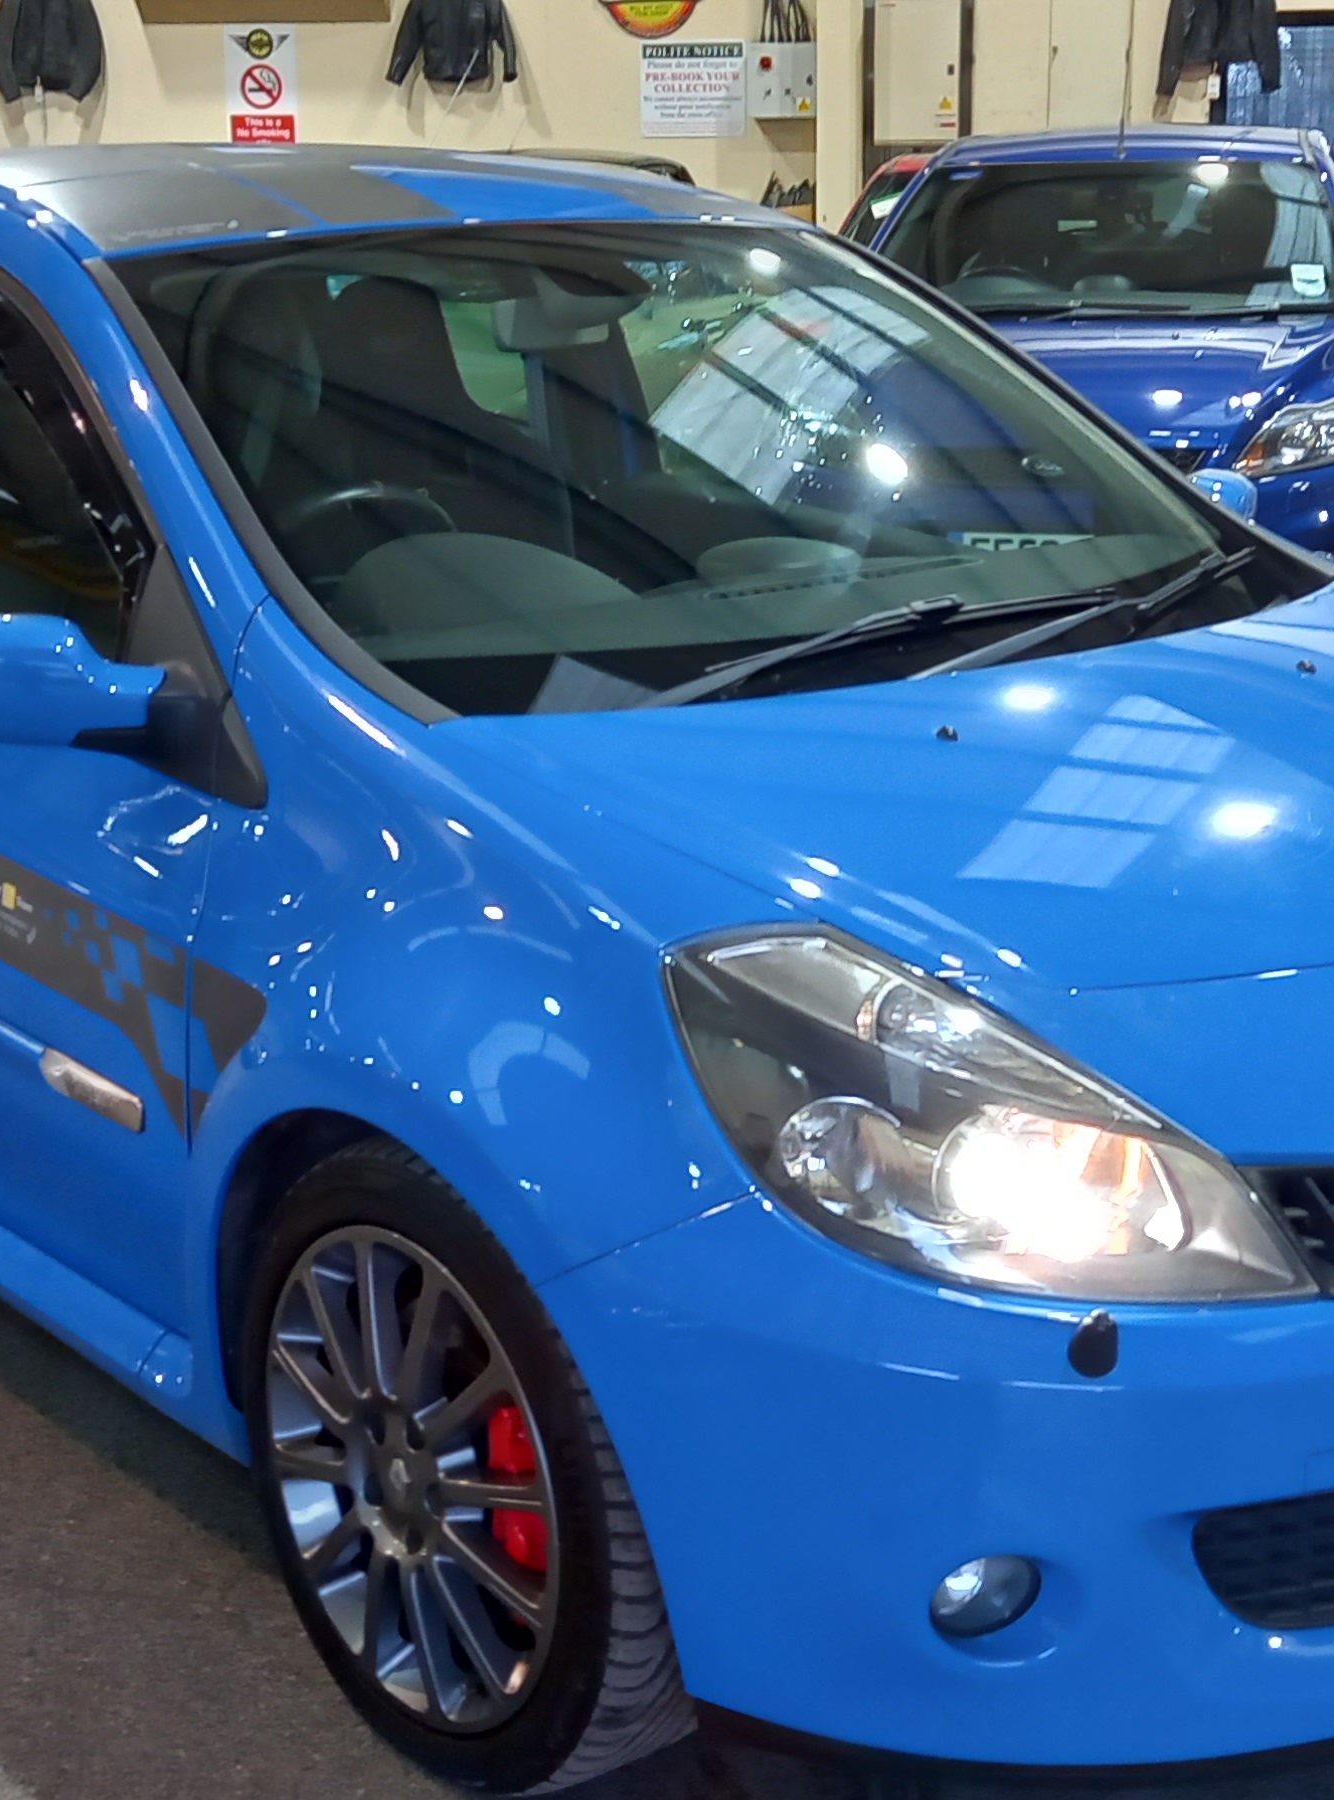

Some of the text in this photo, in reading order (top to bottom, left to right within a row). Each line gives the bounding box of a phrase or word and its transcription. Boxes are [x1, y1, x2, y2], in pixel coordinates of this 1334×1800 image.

[645, 45, 741, 57] POLITE NOTICE
[674, 60, 685, 69] do
[687, 61, 701, 69] not
[645, 71, 740, 82] PRE-BOOK YOUR
[654, 82, 731, 93] COLLECTION
[245, 117, 282, 127] This is a
[236, 127, 291, 139] No Smoking
